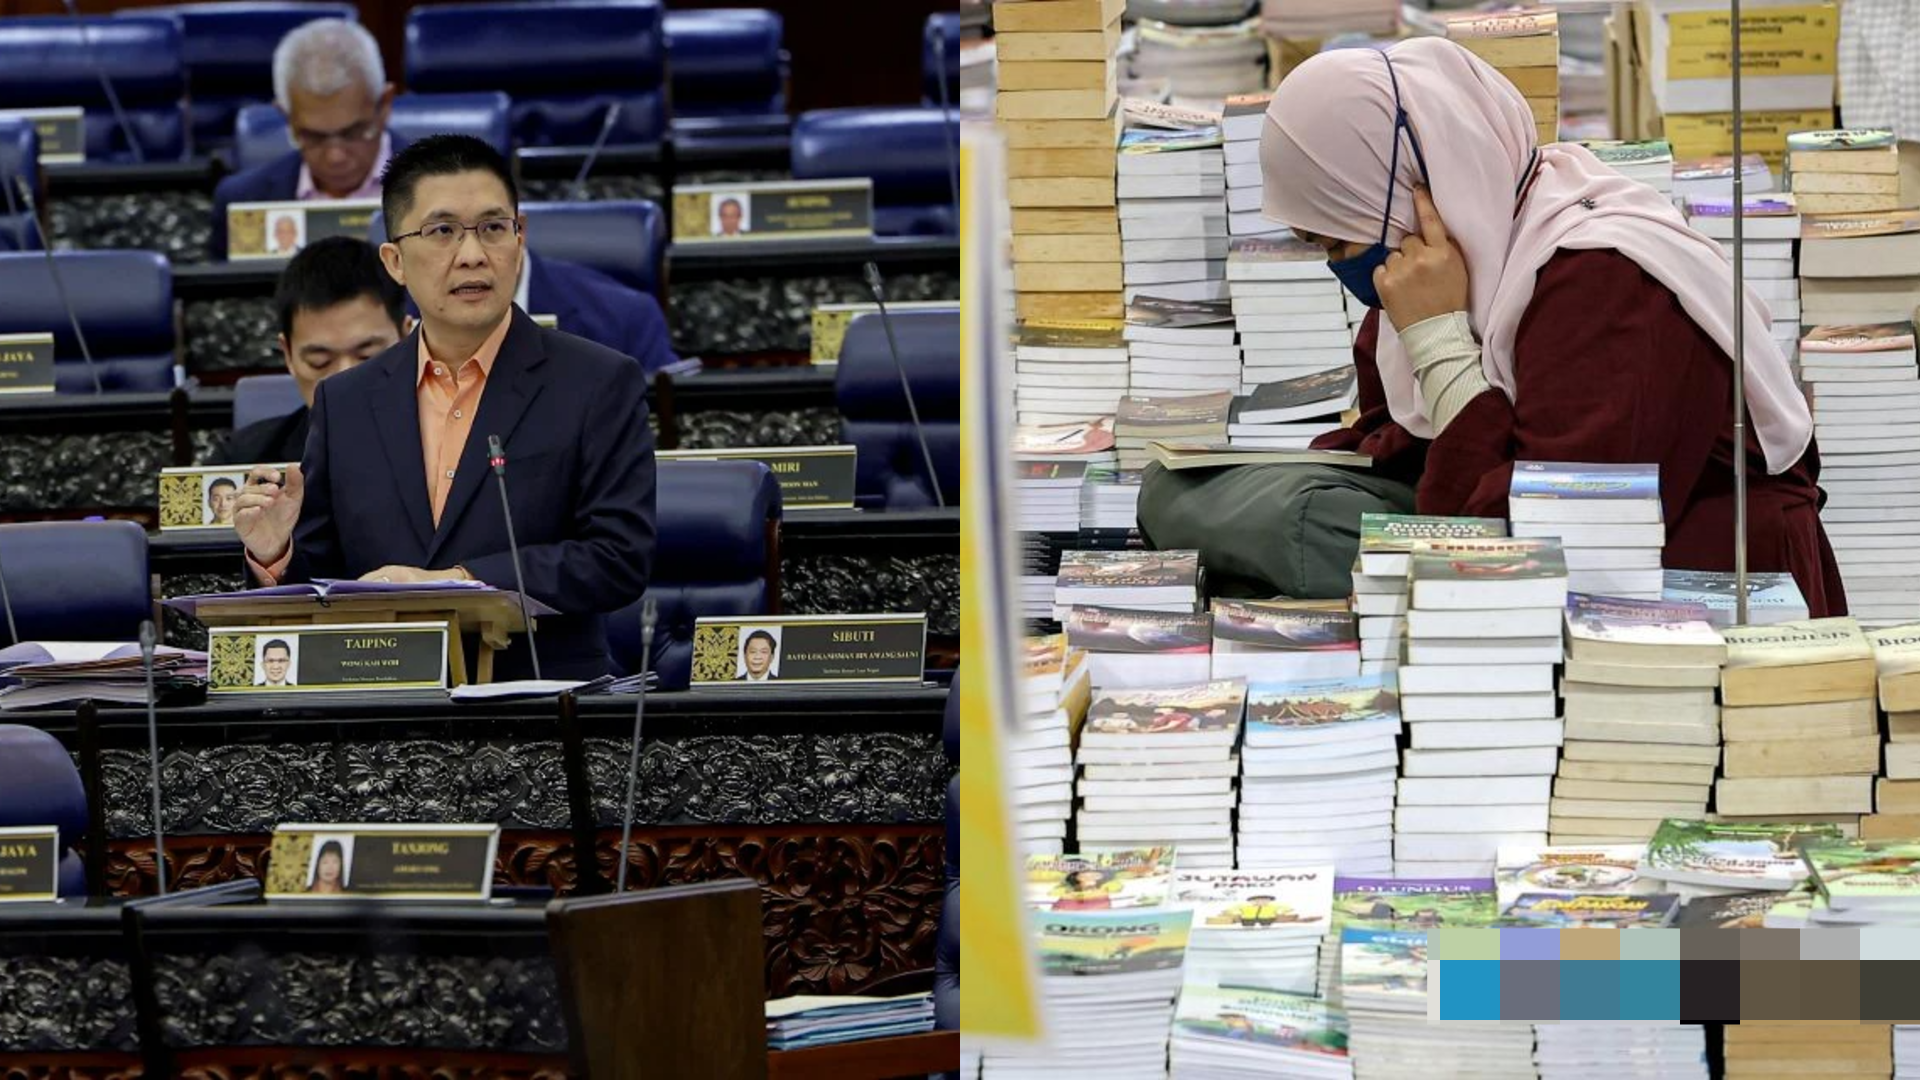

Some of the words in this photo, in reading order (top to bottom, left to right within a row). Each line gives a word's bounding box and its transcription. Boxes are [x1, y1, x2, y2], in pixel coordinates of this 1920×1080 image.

[771, 462, 800, 473] MIRI
[832, 630, 875, 642] SIBUTI
[1725, 631, 1851, 644] BIOGENESIS
[1878, 636, 1920, 647] BIO
[344, 637, 398, 649] TAIPING
[0, 845, 38, 857] JAYA
[1177, 873, 1318, 882] JUTAWAN
